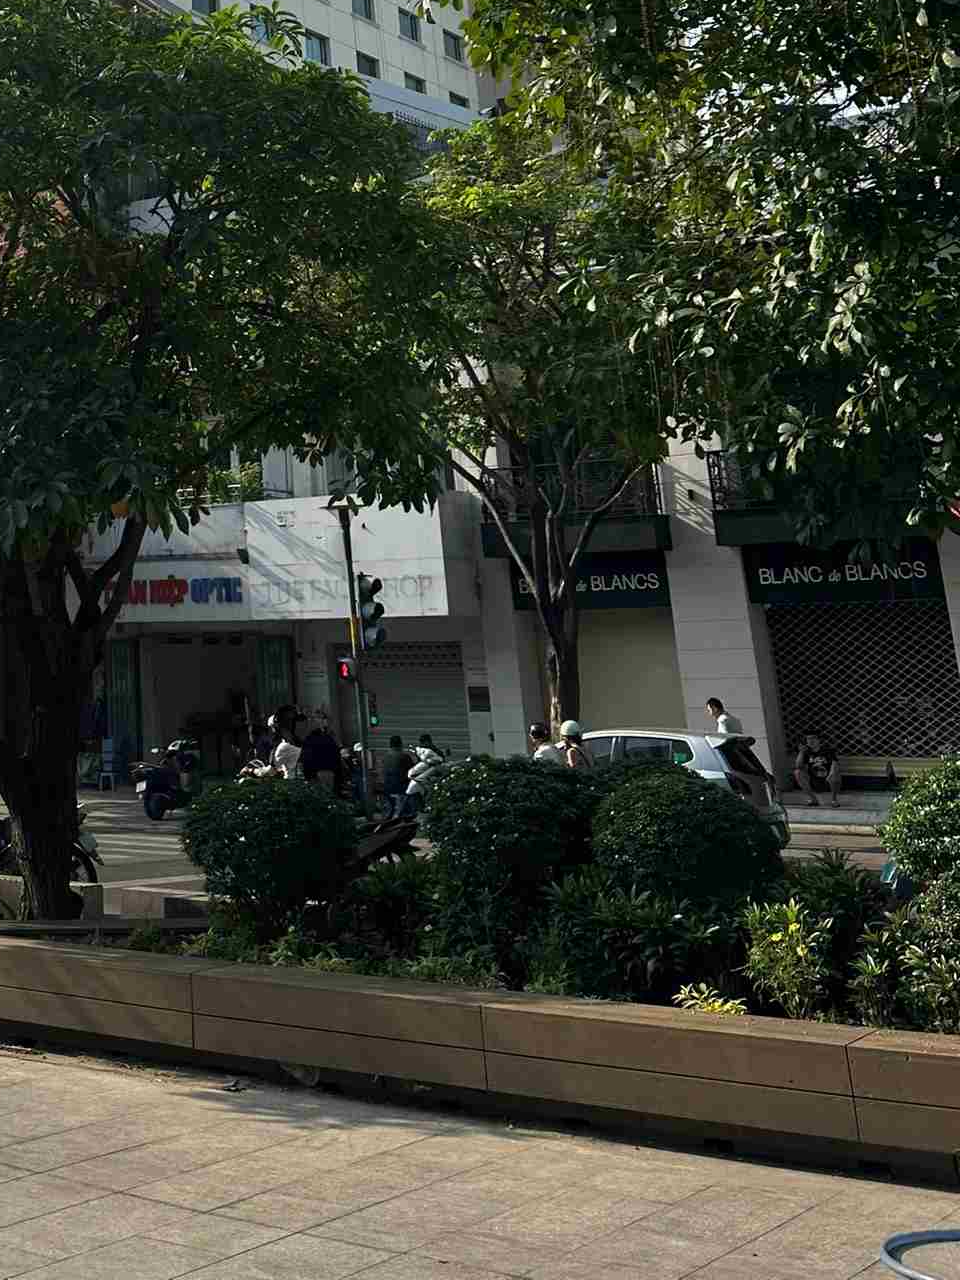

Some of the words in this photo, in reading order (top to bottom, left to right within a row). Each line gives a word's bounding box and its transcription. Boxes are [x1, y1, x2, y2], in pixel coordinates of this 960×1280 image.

[591, 573, 660, 592] BLANCS
[758, 566, 824, 585] BLANC
[828, 569, 841, 583] de
[844, 561, 928, 582] BLANCS
